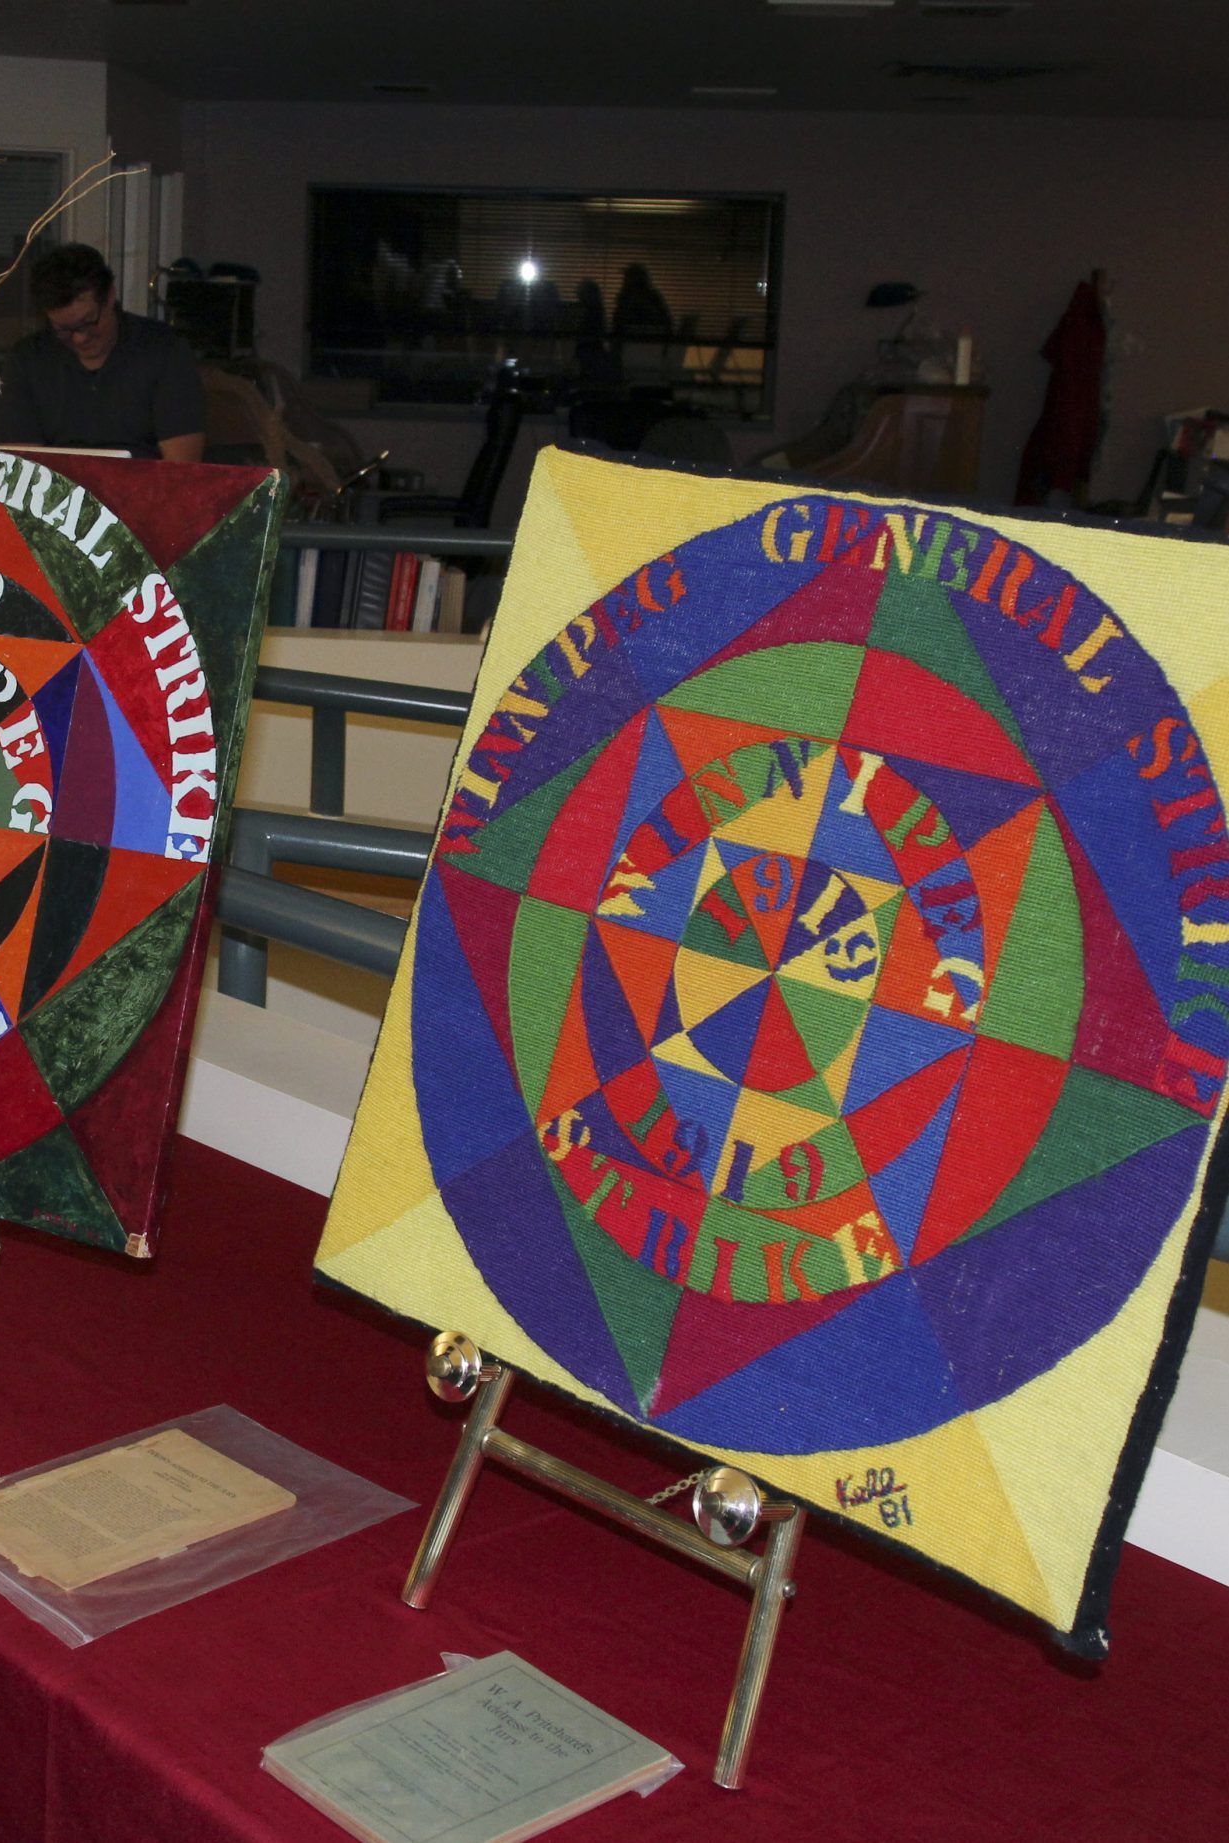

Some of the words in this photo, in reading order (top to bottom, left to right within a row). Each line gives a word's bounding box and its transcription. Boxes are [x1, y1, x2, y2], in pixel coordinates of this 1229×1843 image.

[122, 573, 216, 863] STRIKE
[436, 551, 686, 854] WINNIPEG
[761, 504, 1123, 694] GENERAL
[1125, 717, 1229, 1118] STRIKE
[597, 740, 985, 1021] WINNIPEG
[699, 855, 879, 983] 1919
[538, 1109, 895, 1302] STRIKE
[626, 1088, 824, 1203] 1919
